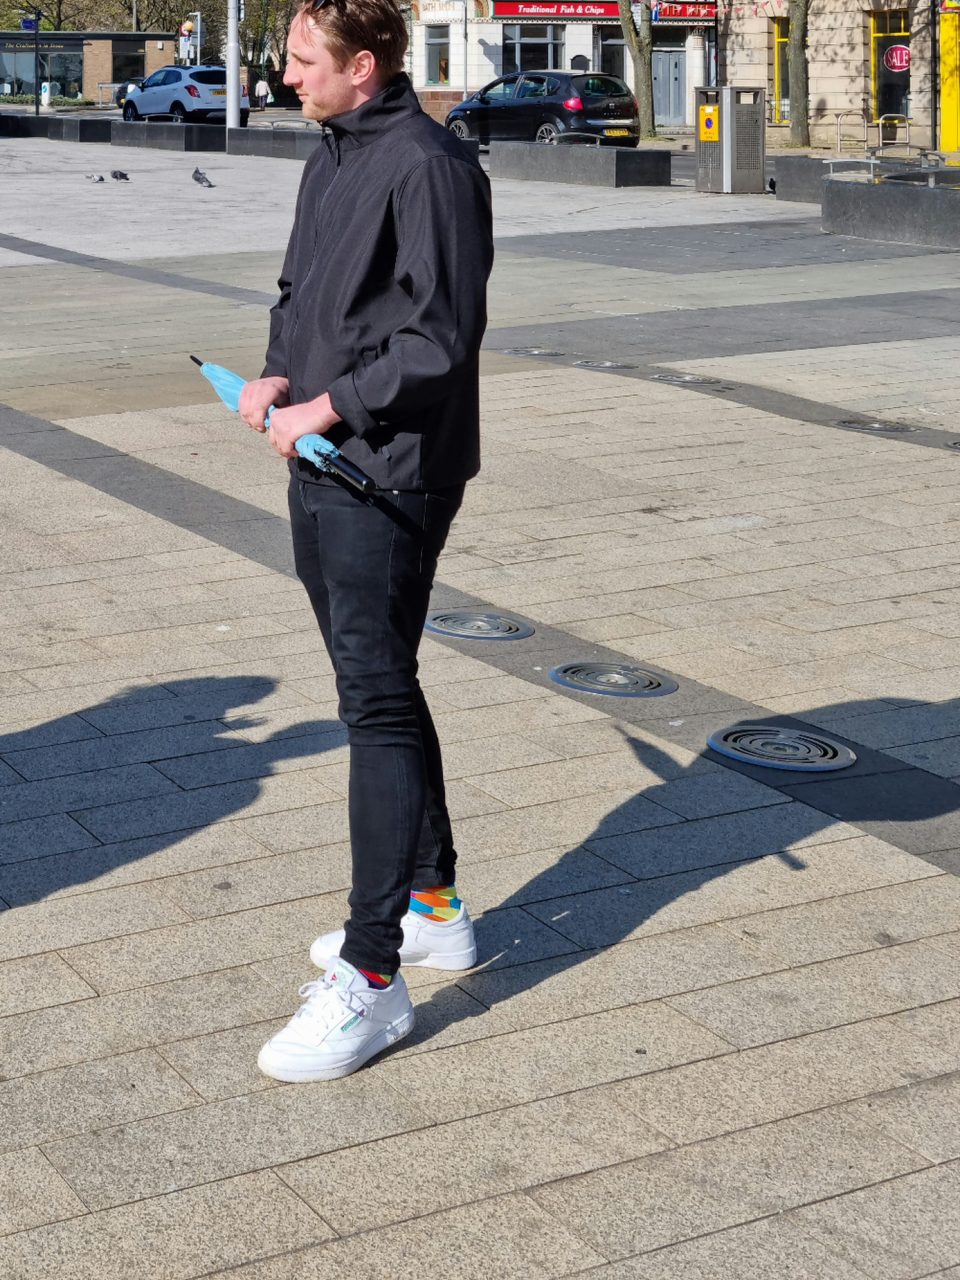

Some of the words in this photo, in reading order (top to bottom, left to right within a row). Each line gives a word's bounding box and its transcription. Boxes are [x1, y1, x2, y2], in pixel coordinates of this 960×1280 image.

[518, 4, 557, 14] Traditional
[560, 5, 575, 14] Fish
[576, 5, 583, 14] &
[584, 5, 605, 15] Chips
[887, 50, 909, 67] SALE
